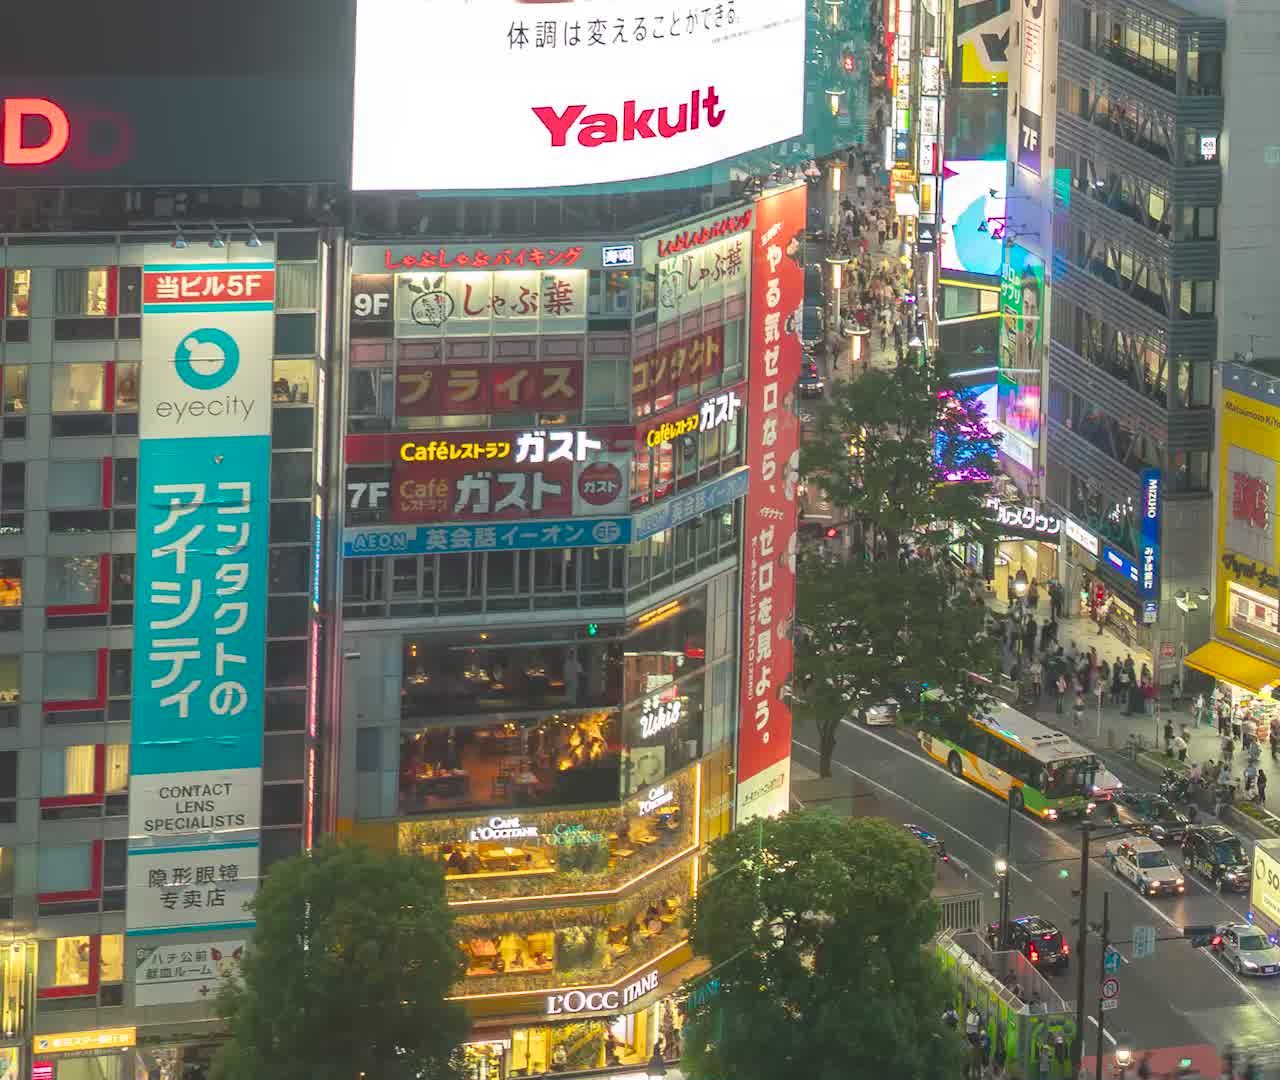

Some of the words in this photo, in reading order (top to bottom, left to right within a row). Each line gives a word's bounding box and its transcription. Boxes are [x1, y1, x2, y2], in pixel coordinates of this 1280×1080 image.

[531, 85, 727, 148] Yakult
[384, 246, 586, 270] しゃぶしゃぶバイキング
[156, 273, 263, 301] 当ビル5F
[463, 282, 575, 316] しゃぶ葉
[354, 293, 389, 316] 9F
[631, 334, 720, 391] コンタクト
[400, 366, 577, 404] プライス
[156, 394, 256, 422] eyecity
[699, 391, 741, 433] ガスト
[400, 441, 511, 462] Caféレストラン
[515, 431, 602, 463] ガスト
[347, 481, 390, 509] 7F
[400, 478, 449, 498] Café
[453, 472, 563, 514] ガスト
[1147, 478, 1158, 519] MIZUHO
[353, 532, 407, 552] AEON
[148, 483, 207, 719] アイシティ
[209, 481, 252, 717] コンタクトの
[755, 523, 775, 745] ゼロを見よう。
[159, 782, 233, 800] CONTACT
[175, 800, 215, 814] LENS
[144, 813, 246, 832] SPECIALISTS
[148, 862, 240, 889] 隐形眼镜
[160, 887, 228, 911] 专卖店
[547, 971, 660, 1015] L'OCCITANE
